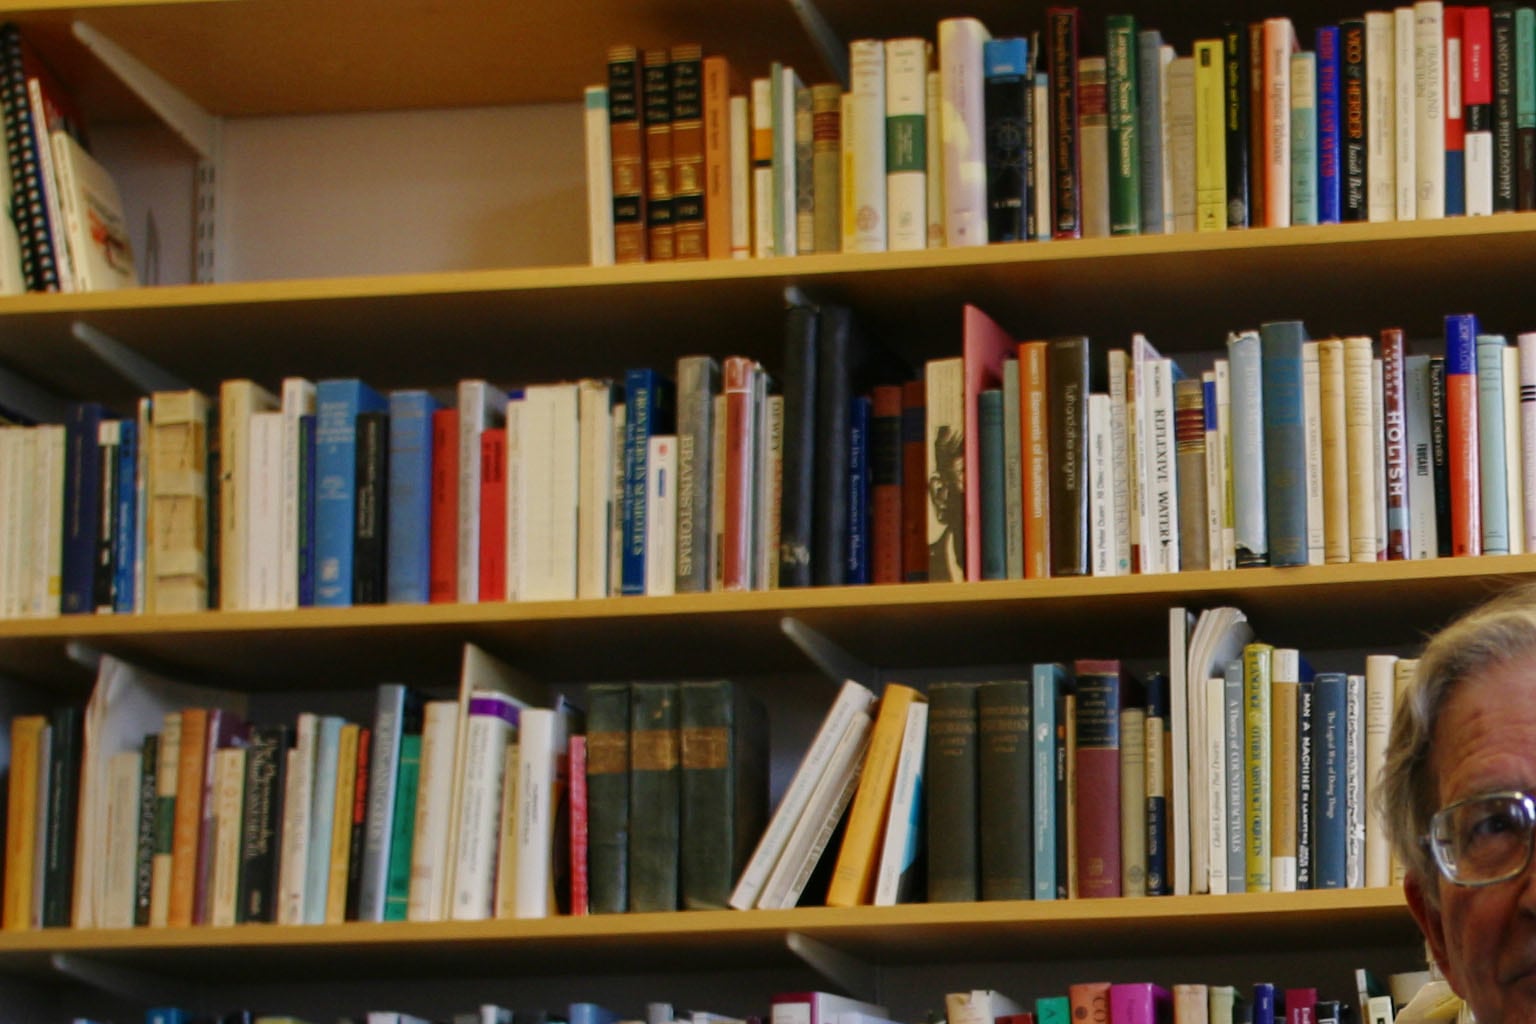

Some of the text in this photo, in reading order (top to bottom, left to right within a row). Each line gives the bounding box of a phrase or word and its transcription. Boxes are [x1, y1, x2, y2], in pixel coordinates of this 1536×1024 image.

[1346, 29, 1361, 139] VICO & HERDER
[1415, 46, 1427, 98] ACTION
[1427, 45, 1439, 121] PRAXIS AND
[1117, 27, 1134, 177] Language, Sense & Nonsense
[1498, 28, 1512, 199] LANGUAGE AND PHILOSOPHY
[1348, 144, 1362, 209] Isaiah Berlin
[772, 401, 781, 453] DEWEY
[1031, 391, 1042, 441] Elements
[1033, 443, 1043, 455] of
[1062, 451, 1077, 491] enigmas
[1154, 408, 1170, 537] REFLEXIVE WATER
[1386, 410, 1404, 497] HOLISM
[1416, 443, 1429, 477] FOUCAULT
[679, 435, 695, 576] BRAINSTORMS
[1228, 709, 1239, 738] Theory
[1231, 741, 1240, 749] of
[1250, 726, 1262, 761] OTHER
[1302, 693, 1312, 792] MAN A MACHINE
[1250, 765, 1262, 814] ABSTRACT
[1325, 711, 1337, 819] The Logical Way of Doing Things
[1230, 752, 1241, 853] COUNTERFACTUALS
[1252, 816, 1263, 857] OBJECTS
[1045, 1007, 1057, 1019] A
